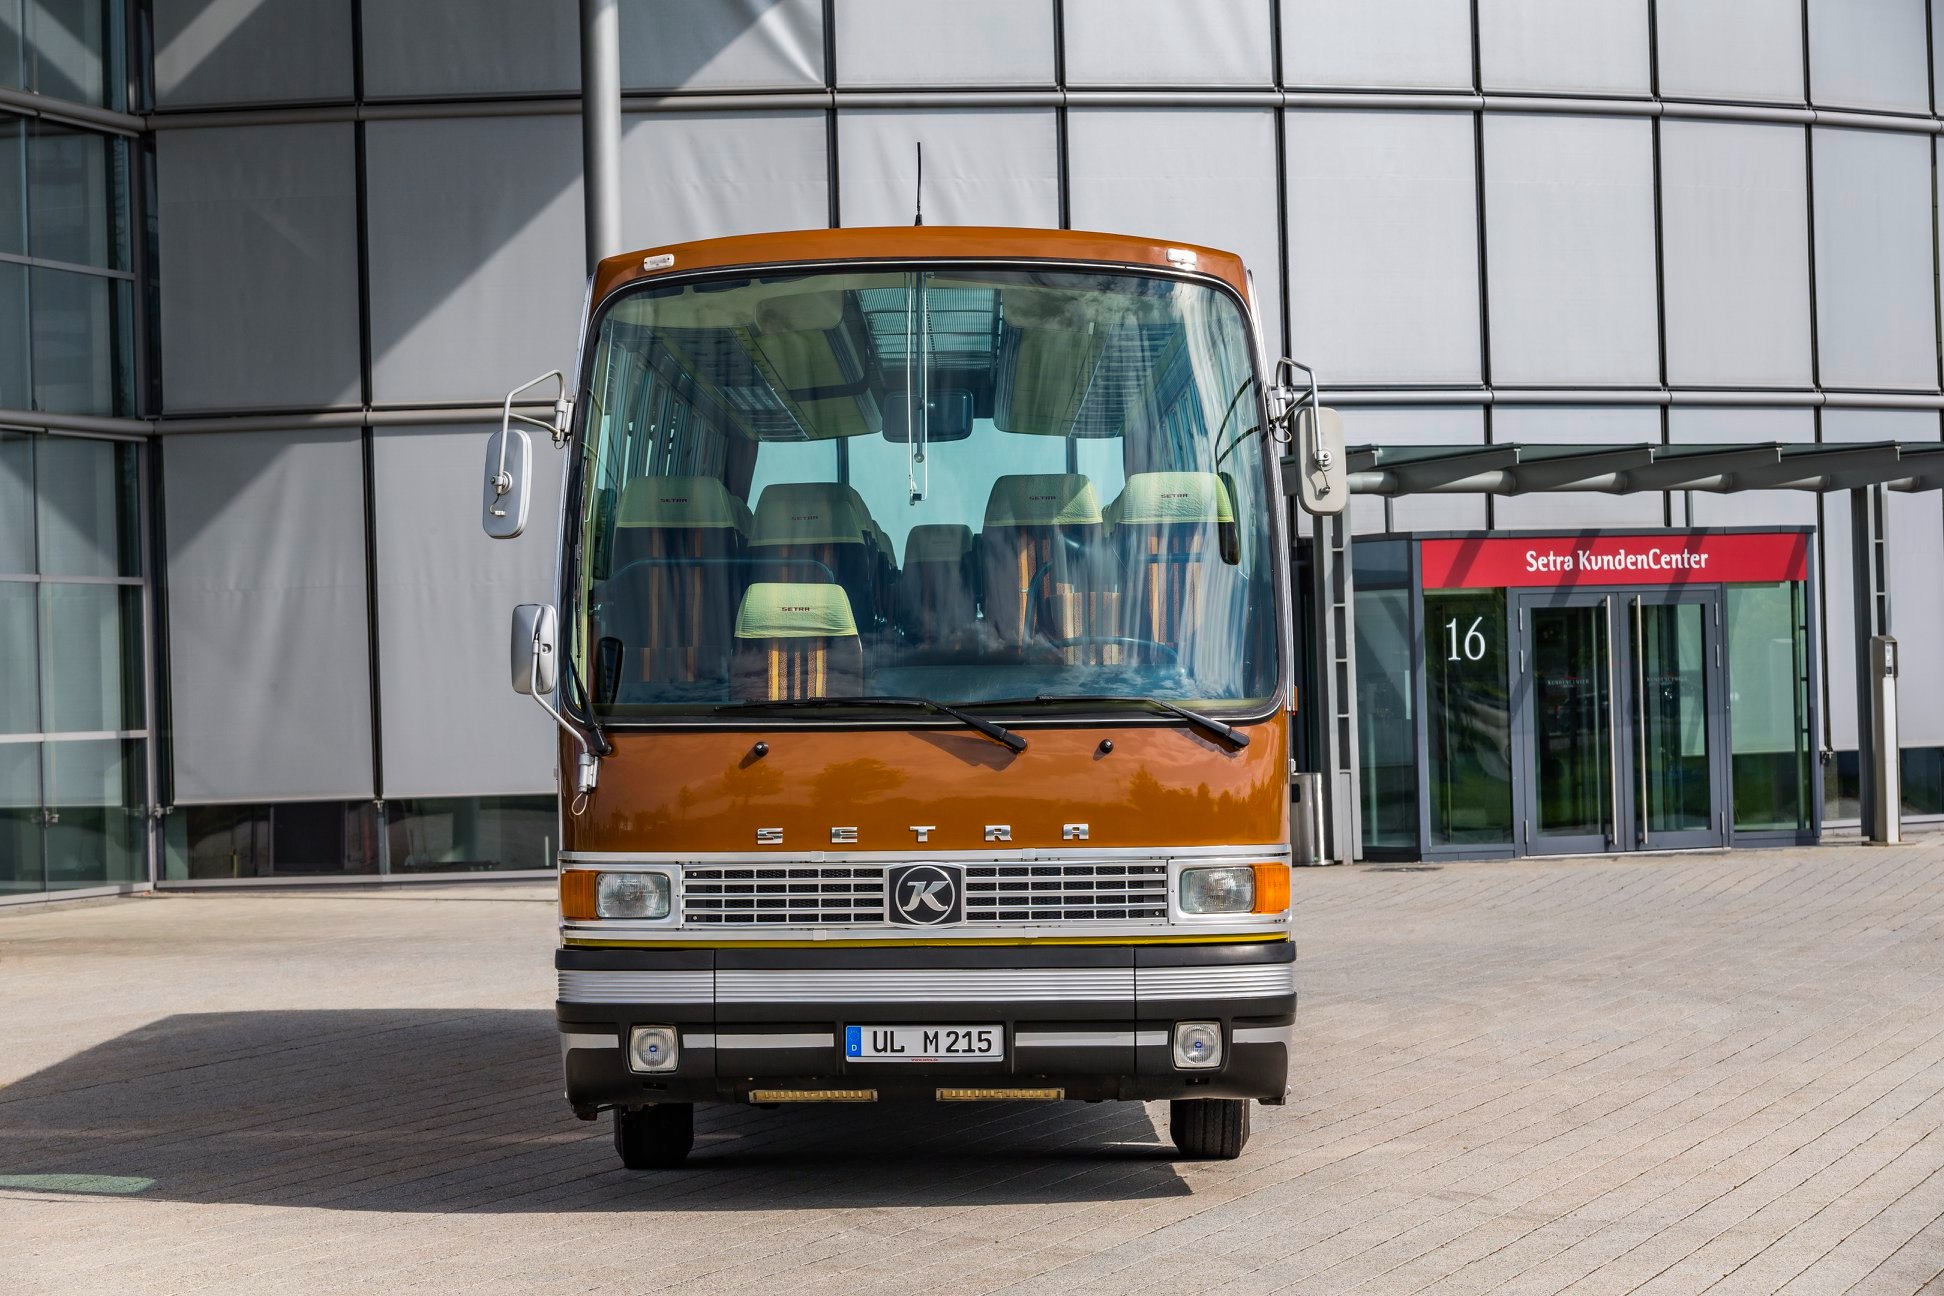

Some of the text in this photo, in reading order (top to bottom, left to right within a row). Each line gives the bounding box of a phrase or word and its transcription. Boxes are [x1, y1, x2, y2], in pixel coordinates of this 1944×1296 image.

[1526, 548, 1709, 572] Setra KundenCenter
[1446, 616, 1486, 661] 16
[757, 823, 1089, 845] SETRA
[872, 1030, 905, 1053] UL
